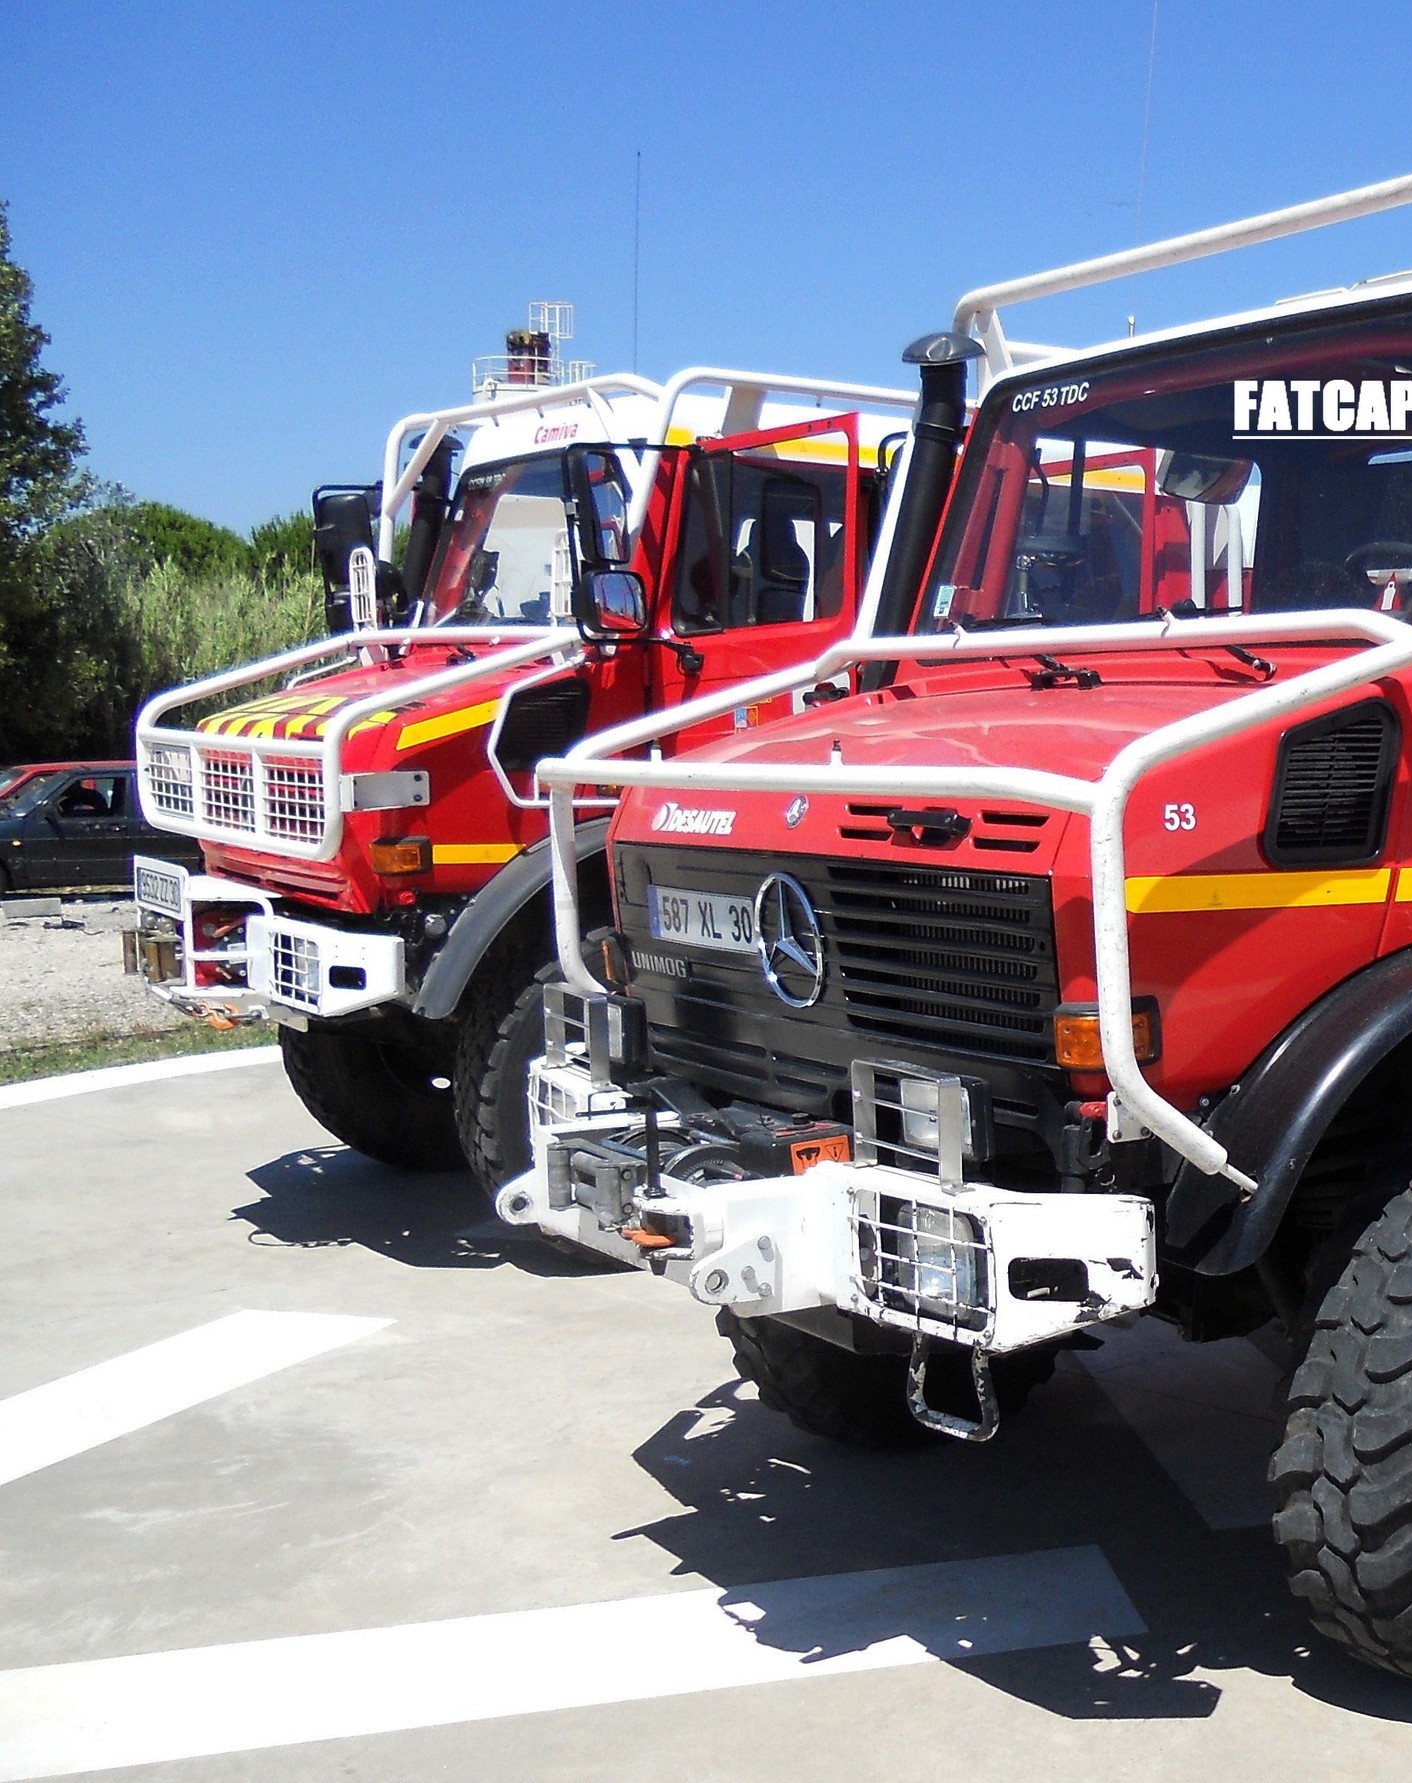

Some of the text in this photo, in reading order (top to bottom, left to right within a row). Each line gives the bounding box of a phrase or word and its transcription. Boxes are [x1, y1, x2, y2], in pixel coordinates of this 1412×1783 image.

[1012, 382, 1089, 412] CCF 53 TDC
[534, 423, 579, 444] Camiva
[665, 807, 737, 835] DESAUTEL
[1164, 803, 1197, 831] 53
[661, 896, 753, 944] 587 XL 30
[631, 951, 687, 978] UNIMOG
